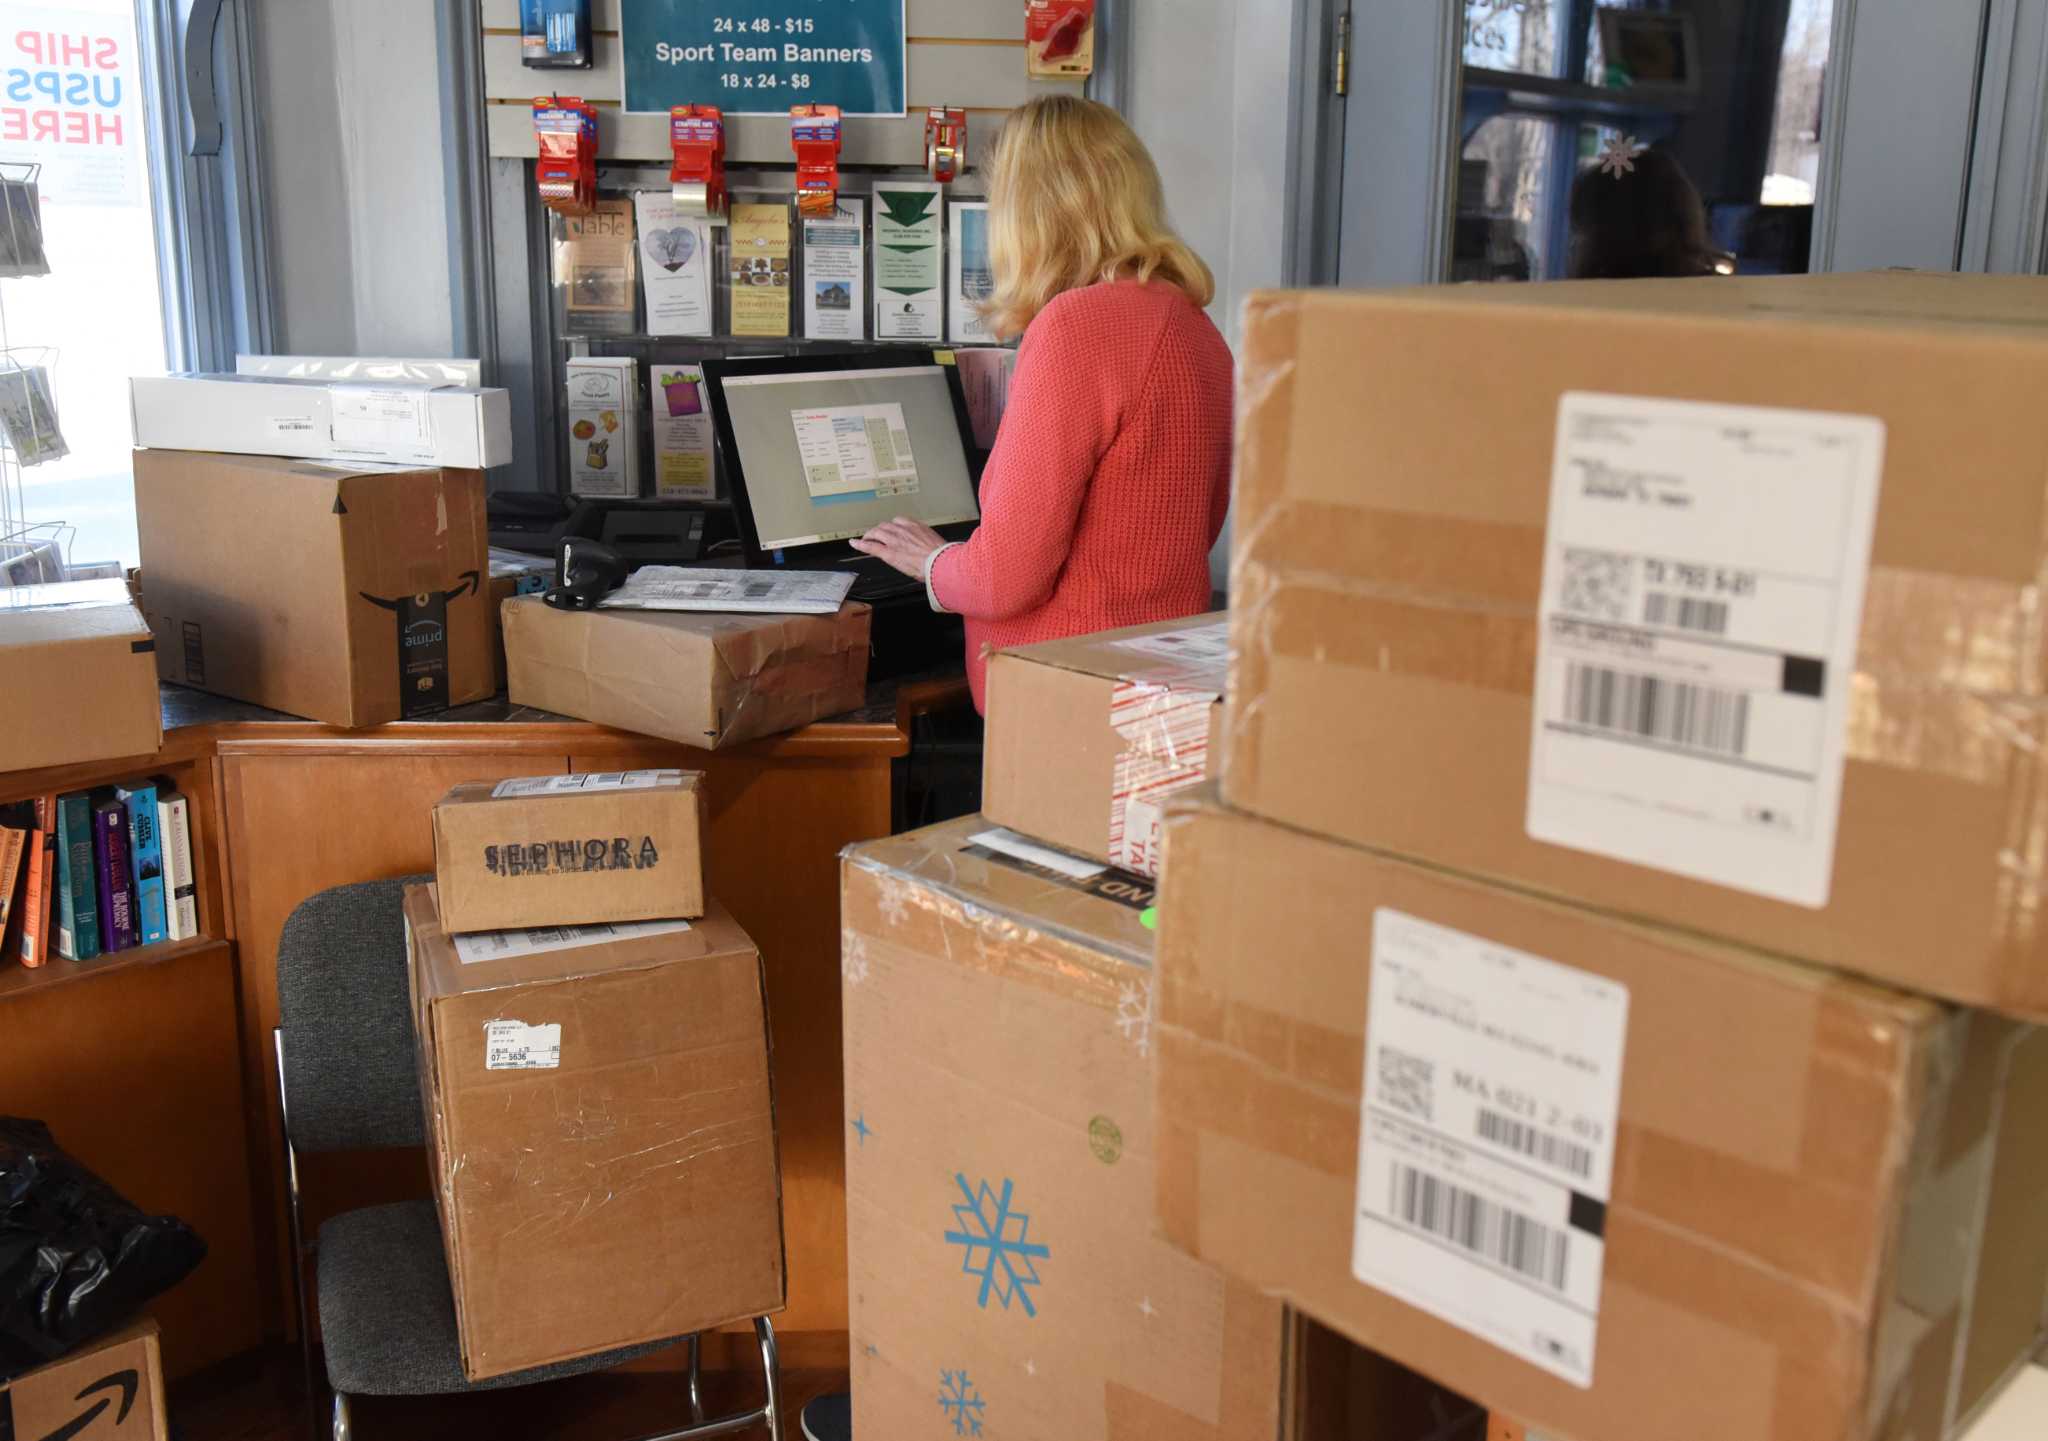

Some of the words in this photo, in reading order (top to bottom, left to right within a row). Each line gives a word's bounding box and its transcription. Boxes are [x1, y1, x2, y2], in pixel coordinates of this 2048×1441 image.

[713, 18, 733, 32] 24
[737, 22, 747, 32] x
[751, 18, 770, 32] 48
[785, 17, 814, 34] $15
[656, 43, 714, 65] Sport
[720, 43, 777, 62] Team
[783, 44, 873, 63] Banners
[721, 74, 739, 88] 18
[743, 78, 753, 88] x
[758, 74, 777, 88] 24
[792, 73, 810, 89] $8
[405, 630, 442, 648] prime
[484, 835, 659, 867] SEPHORA
[1100, 881, 1155, 906] ND
